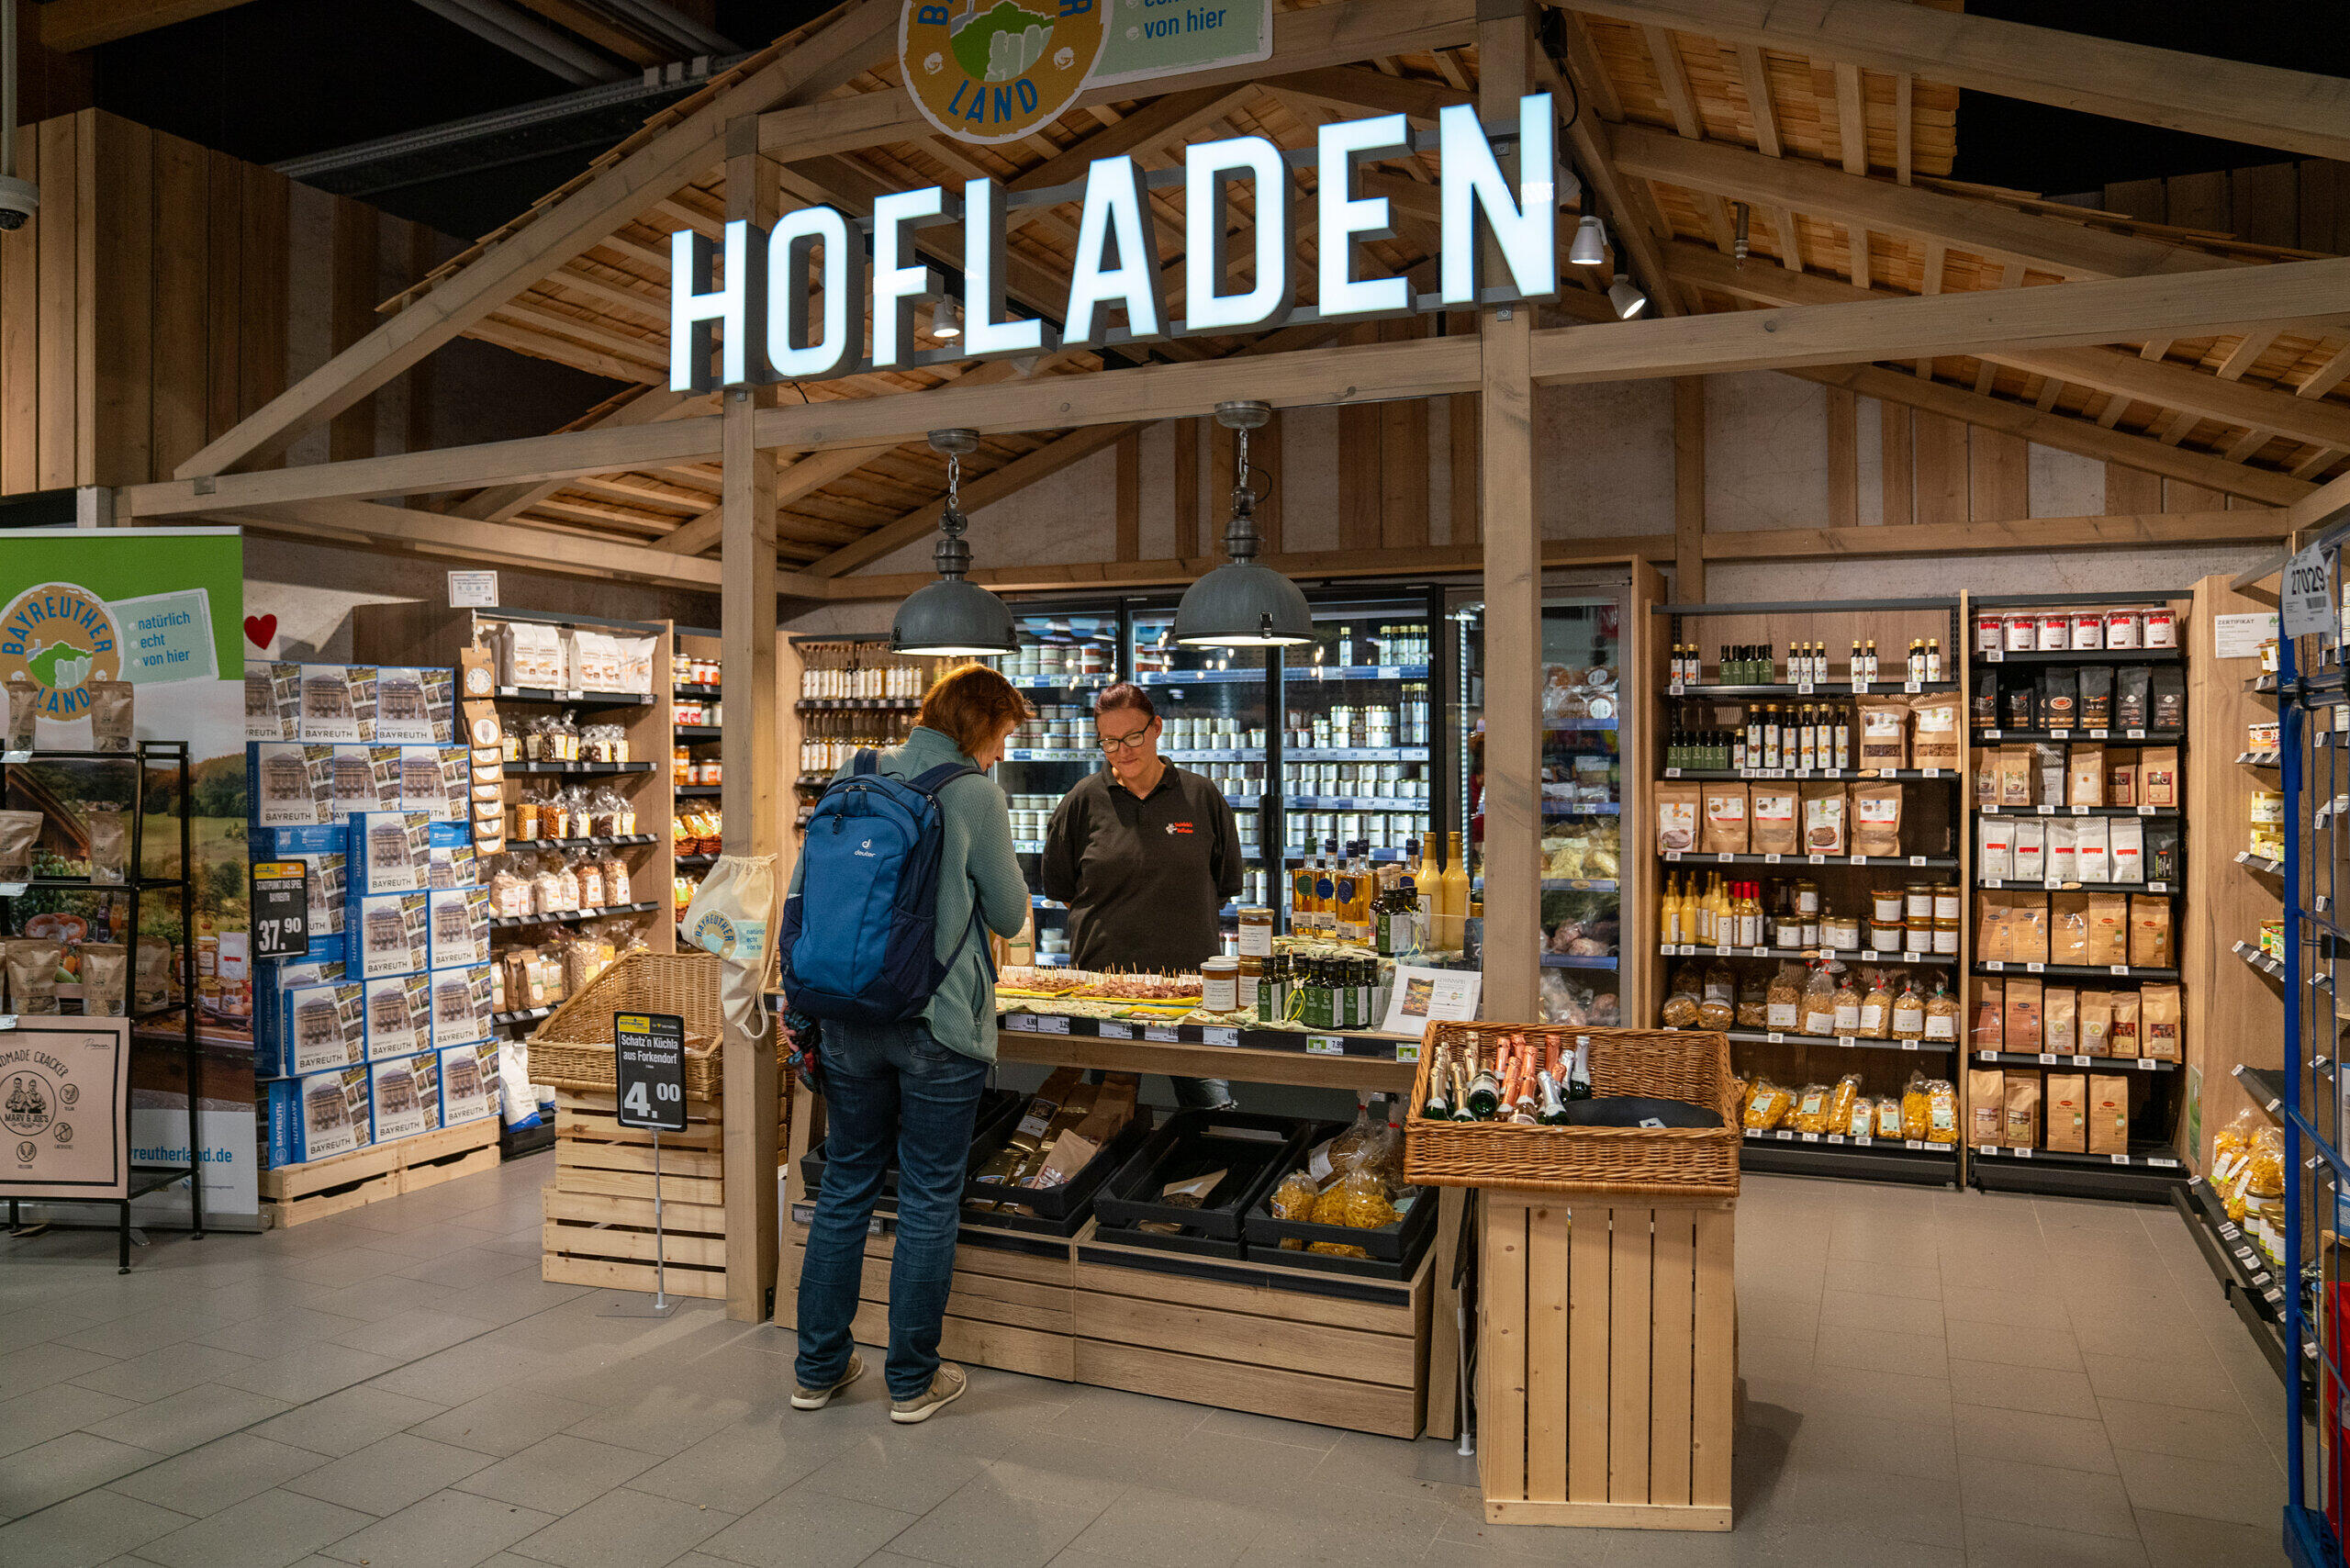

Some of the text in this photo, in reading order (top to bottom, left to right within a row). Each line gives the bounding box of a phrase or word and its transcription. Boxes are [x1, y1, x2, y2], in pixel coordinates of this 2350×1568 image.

[1145, 7, 1227, 39] von hier
[947, 78, 1039, 124] LAND
[669, 93, 1557, 393] HOFLADEN
[2290, 566, 2325, 596] 27029
[1, 596, 113, 655] BAYREUTHER
[138, 611, 191, 631] natürlich
[140, 633, 165, 648] echt
[142, 649, 191, 667] von hier
[38, 687, 91, 714] LAND
[245, 729, 277, 737] REUTH
[305, 730, 353, 739] BAYREUTH
[378, 731, 428, 740] BAYREUTH
[264, 812, 312, 822] BAYREUTH
[854, 849, 877, 857] deuter
[372, 879, 412, 889] BAYREUTH
[695, 913, 734, 942] BAYREUTHER
[435, 953, 472, 964] BAYREUTH
[367, 961, 408, 973] BAYREUTH
[437, 1031, 474, 1043] BAYREUTH
[621, 1034, 678, 1050] Schatz'n Küchla
[373, 1042, 412, 1055] BAYREUTH
[0, 1048, 69, 1079] DMADE CRACKER
[299, 1054, 343, 1069] BAYREUTH
[623, 1050, 677, 1065] aus Forkendorf
[448, 1105, 485, 1121] BAYREUTH
[275, 1102, 284, 1147] BAYREUTH
[379, 1121, 420, 1137] BAYREUTH
[310, 1137, 351, 1154] BAYREUTH
